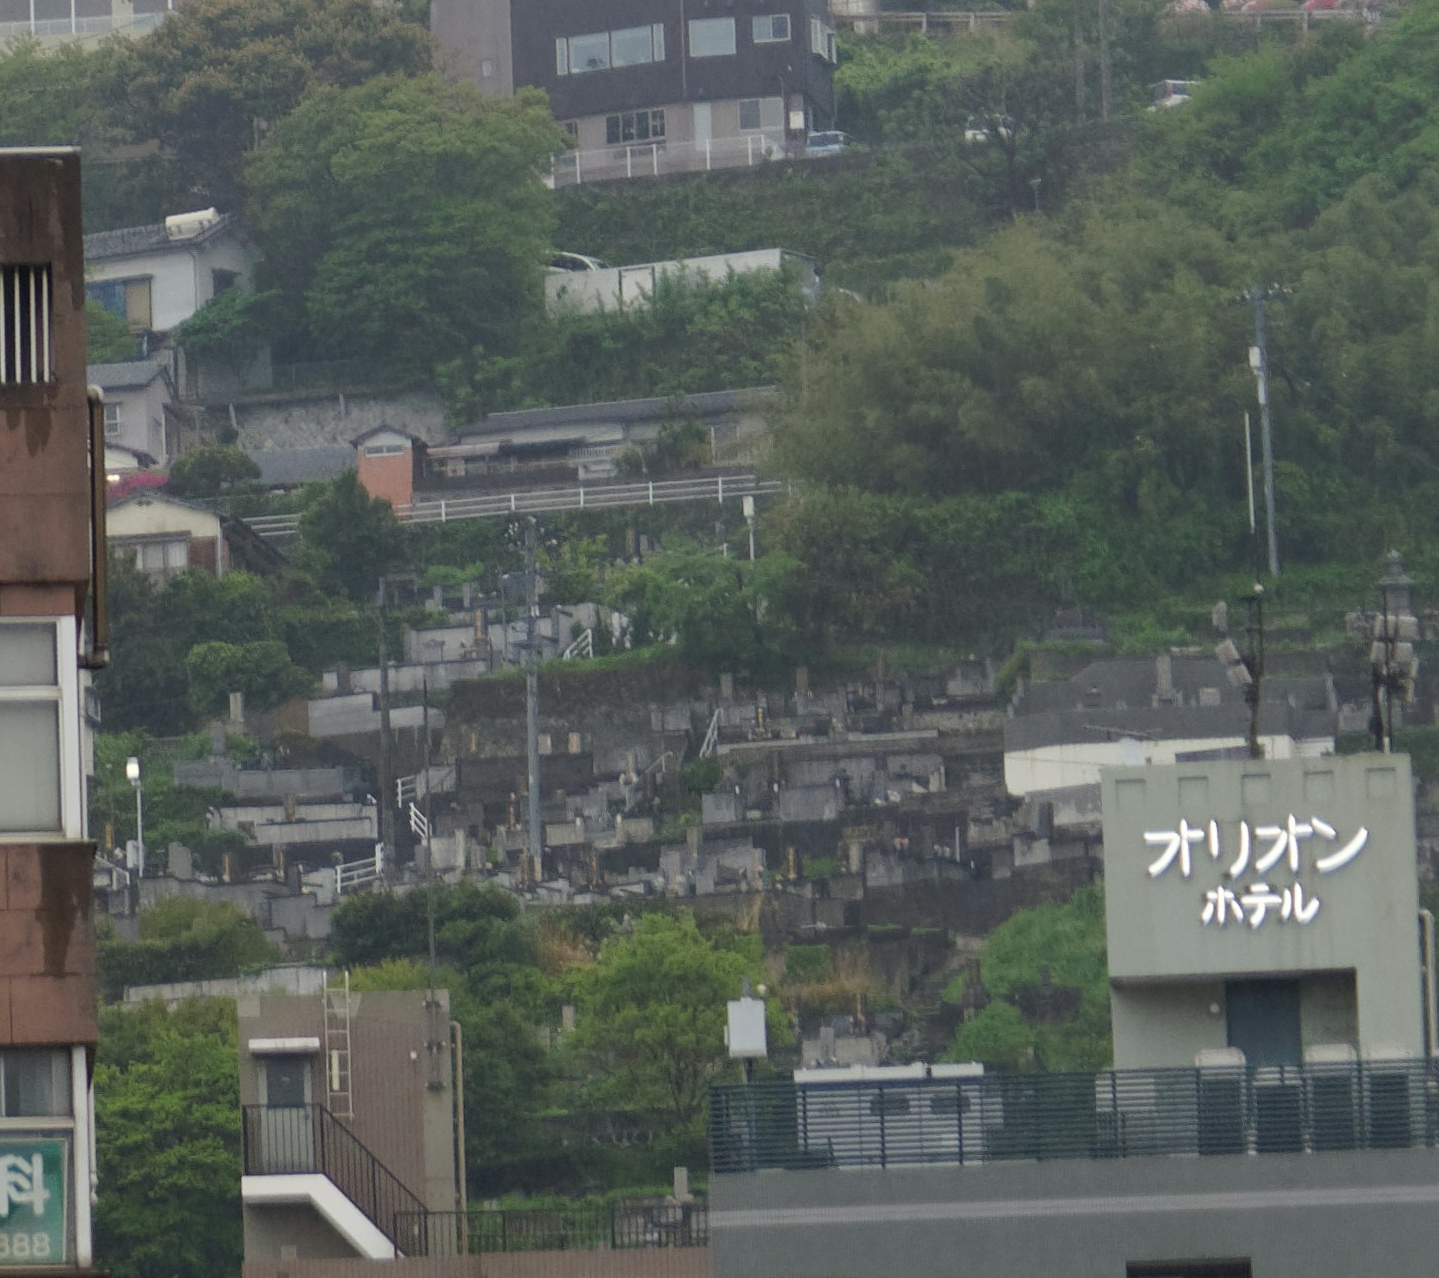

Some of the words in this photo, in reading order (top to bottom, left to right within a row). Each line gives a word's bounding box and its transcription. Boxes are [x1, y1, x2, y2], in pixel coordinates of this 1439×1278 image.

[1144, 813, 1368, 877] オリオン
[1201, 882, 1320, 928] ホテル
